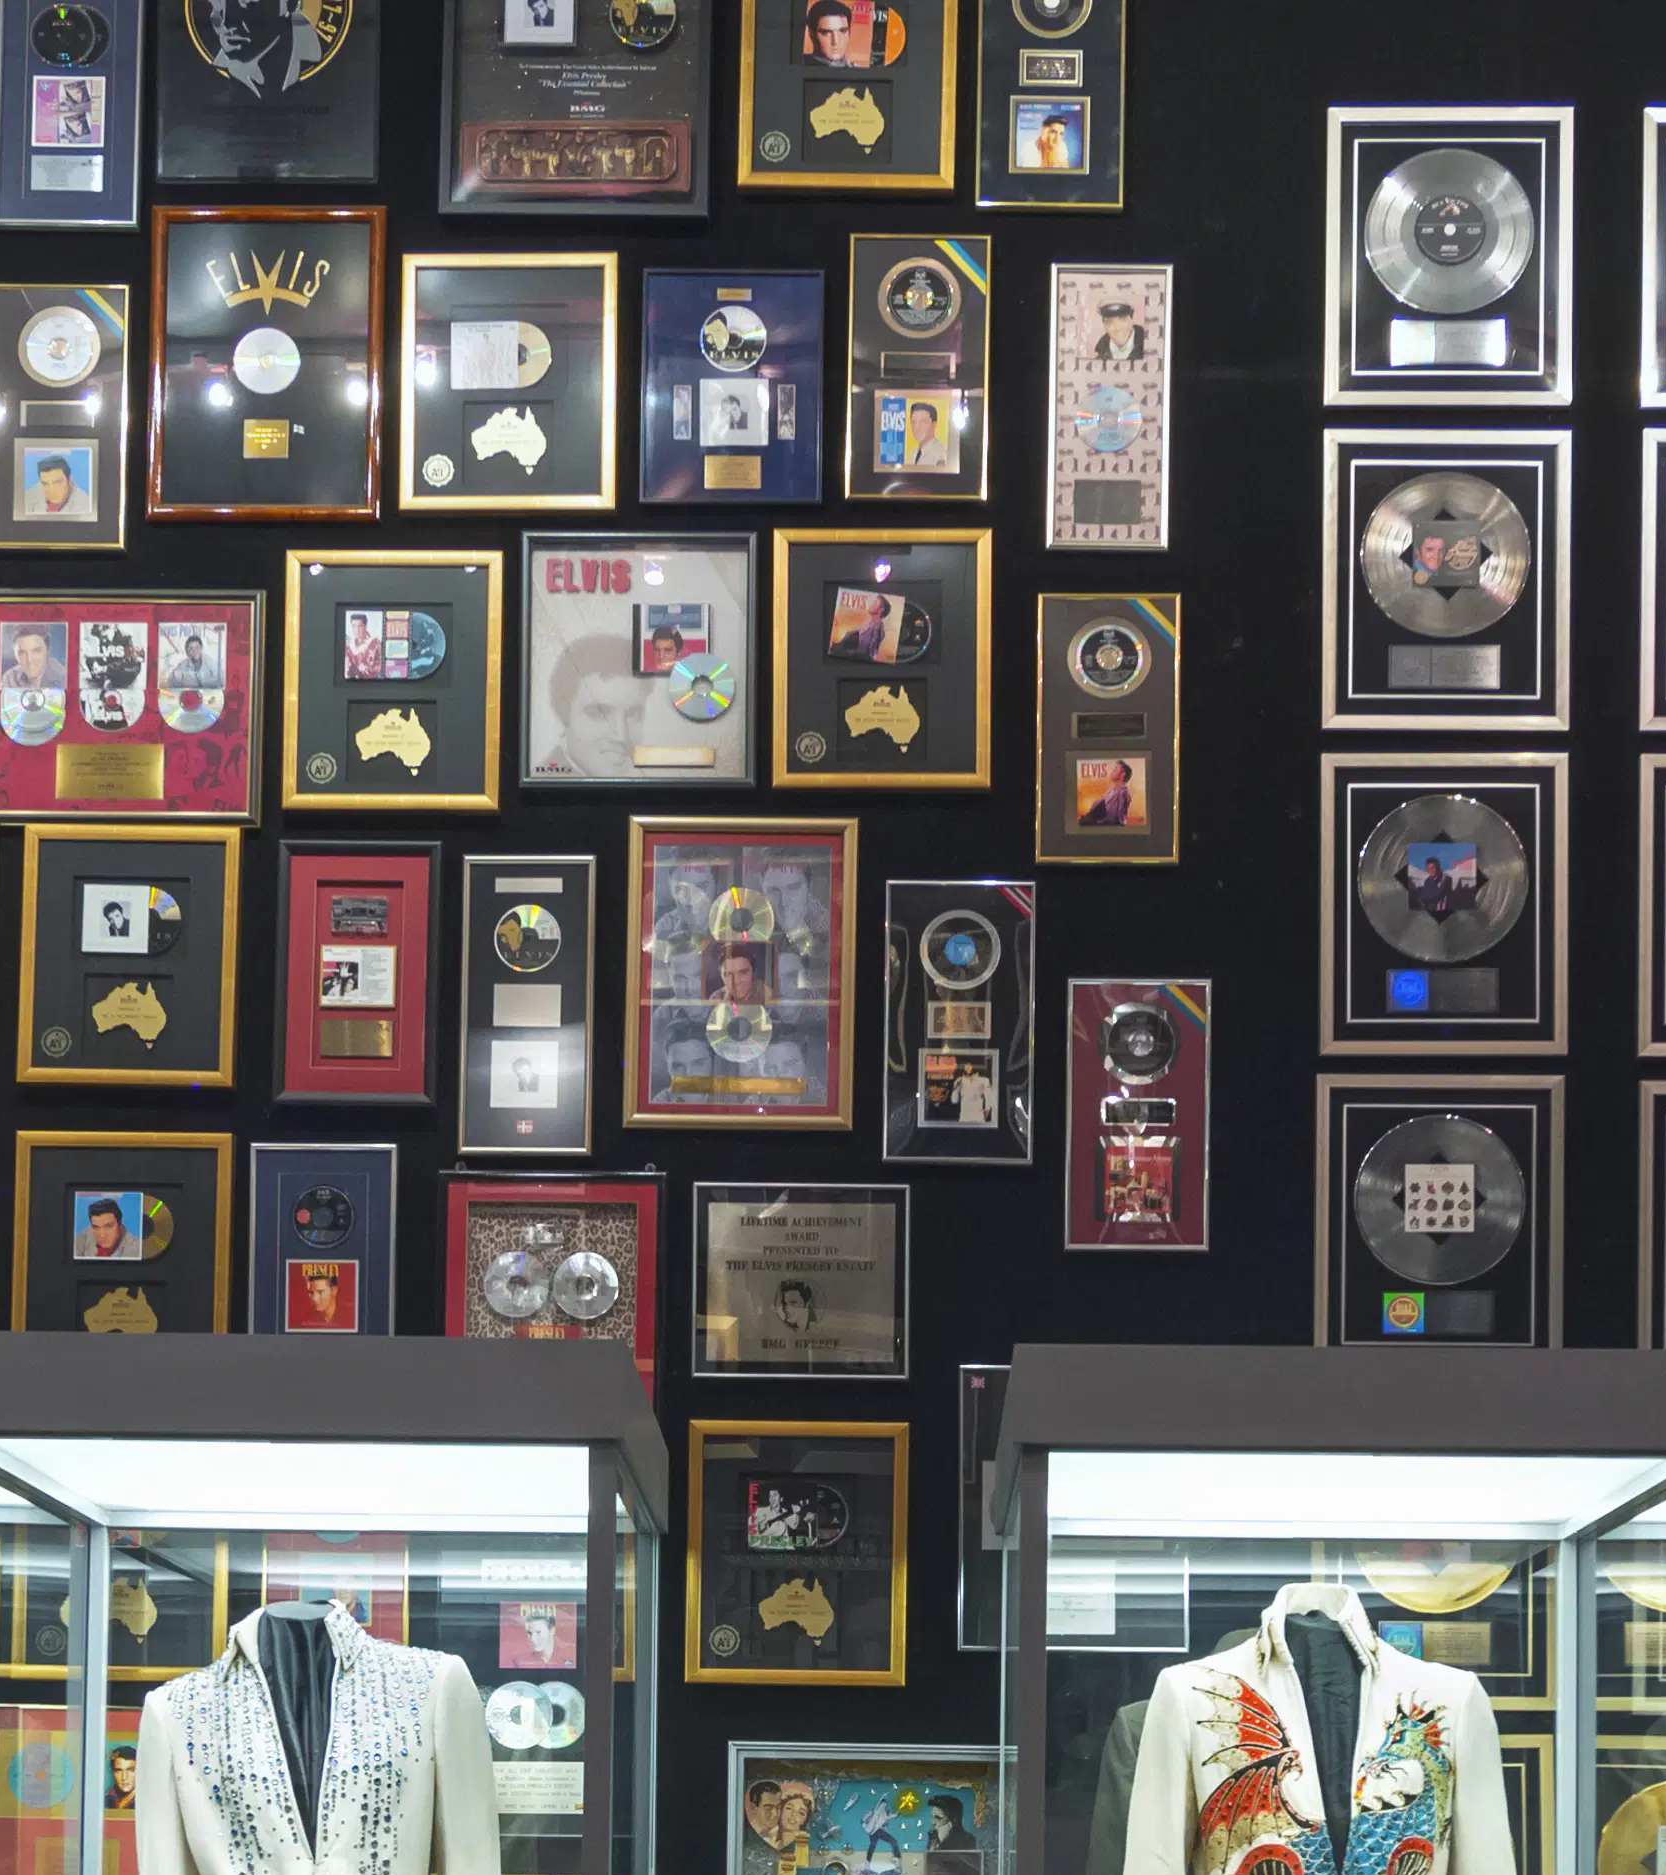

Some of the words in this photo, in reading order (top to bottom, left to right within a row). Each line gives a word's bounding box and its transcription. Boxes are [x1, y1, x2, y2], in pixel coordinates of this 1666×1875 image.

[206, 249, 330, 310] ELVIS
[881, 411, 905, 432] ELVIS
[546, 559, 633, 594] ELVIS
[841, 591, 869, 609] ELVIS
[1081, 763, 1108, 779] ELVIS
[740, 1216, 788, 1227] LIFETIME
[791, 1217, 863, 1228] ACHIEVEMENT
[785, 1232, 819, 1241] AWARD
[763, 1246, 821, 1255] PRESENTED
[302, 1263, 340, 1277] PRESLEY
[725, 1260, 749, 1271] THE
[752, 1260, 782, 1271] ELVIS
[786, 1260, 833, 1271] PRESLEY
[836, 1261, 876, 1272] ESTATE
[528, 1325, 565, 1338] PRESLEY
[761, 1338, 787, 1349] BMG
[748, 1483, 759, 1536] ELVIS
[749, 1536, 813, 1547] PRESLEY
